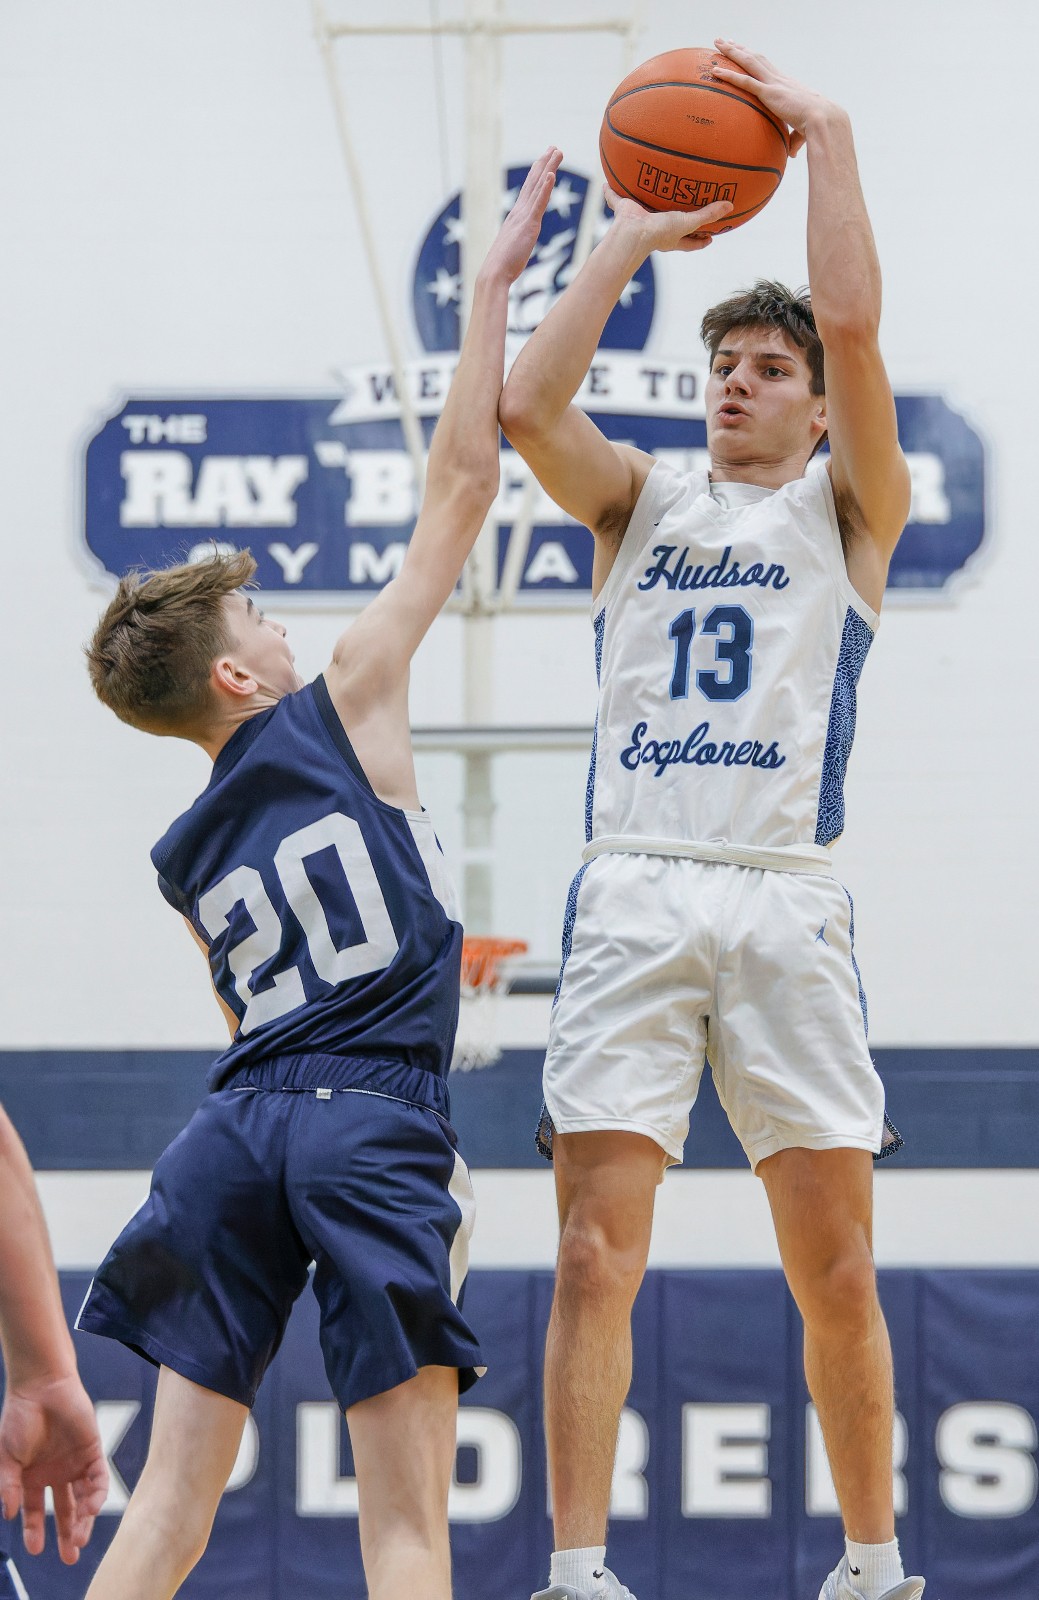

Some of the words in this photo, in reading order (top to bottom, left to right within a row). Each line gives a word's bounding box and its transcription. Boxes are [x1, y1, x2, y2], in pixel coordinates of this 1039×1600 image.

[641, 369, 697, 401] TO
[121, 414, 207, 444] THE
[119, 449, 308, 527] RAY
[637, 545, 790, 591] Hudson
[668, 603, 755, 702] 13
[620, 721, 786, 777] Explorers
[198, 811, 400, 1037] 20
